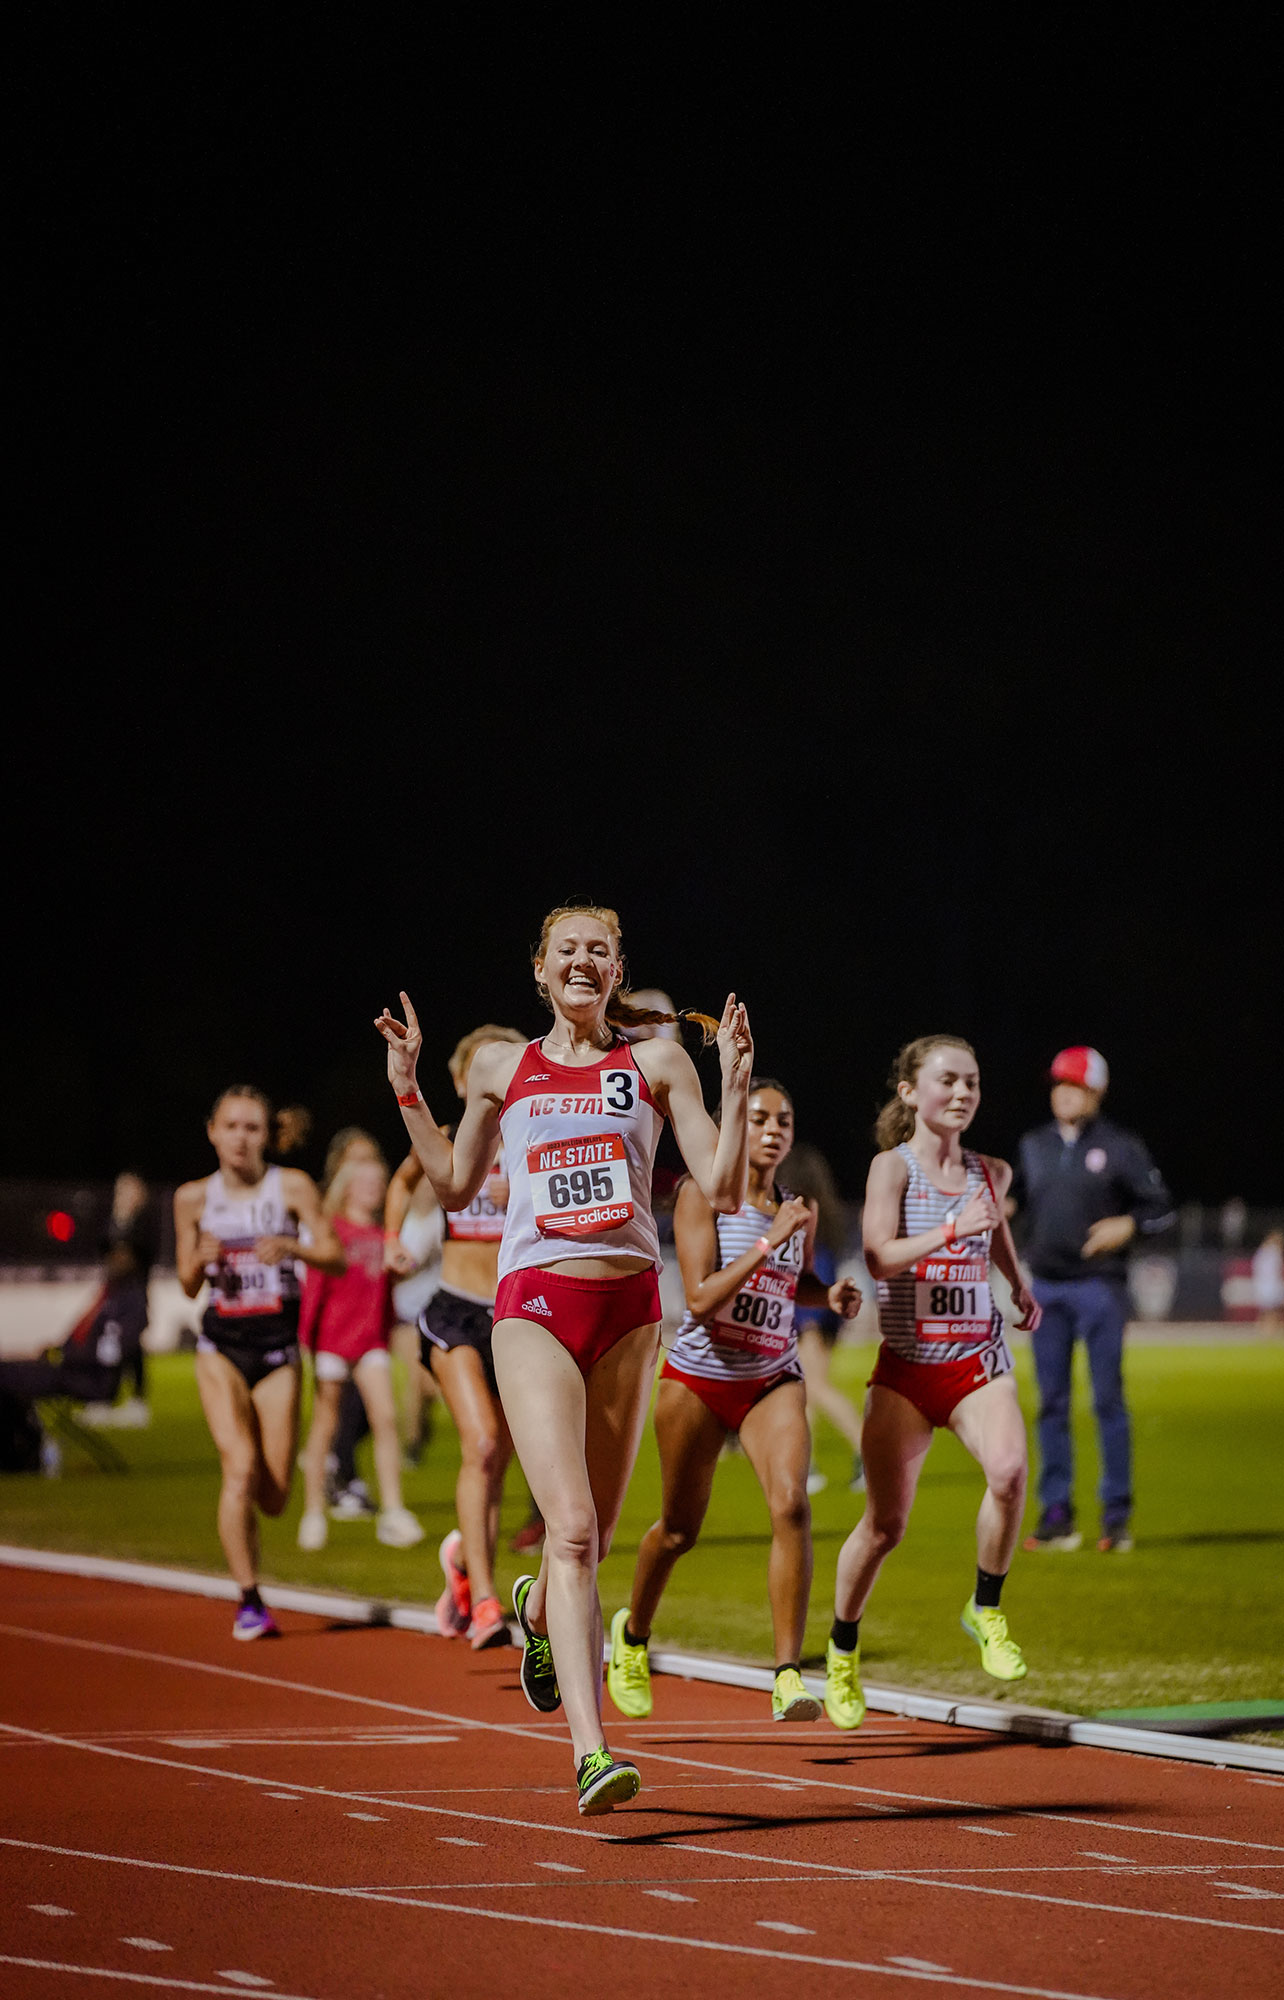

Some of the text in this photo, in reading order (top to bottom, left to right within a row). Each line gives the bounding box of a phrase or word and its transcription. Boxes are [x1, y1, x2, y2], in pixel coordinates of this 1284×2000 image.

[524, 1073, 551, 1083] ACC
[606, 1072, 634, 1111] 3
[529, 1097, 604, 1118] NC STAT
[539, 1142, 614, 1170] NC STATE
[548, 1166, 614, 1209] 695
[577, 1206, 629, 1225] adidas
[925, 1264, 947, 1281] NC
[521, 1302, 553, 1317] adidas
[930, 1285, 976, 1316] 801
[731, 1292, 782, 1330] 803
[950, 1322, 988, 1334] adidas
[747, 1333, 785, 1350] adidas
